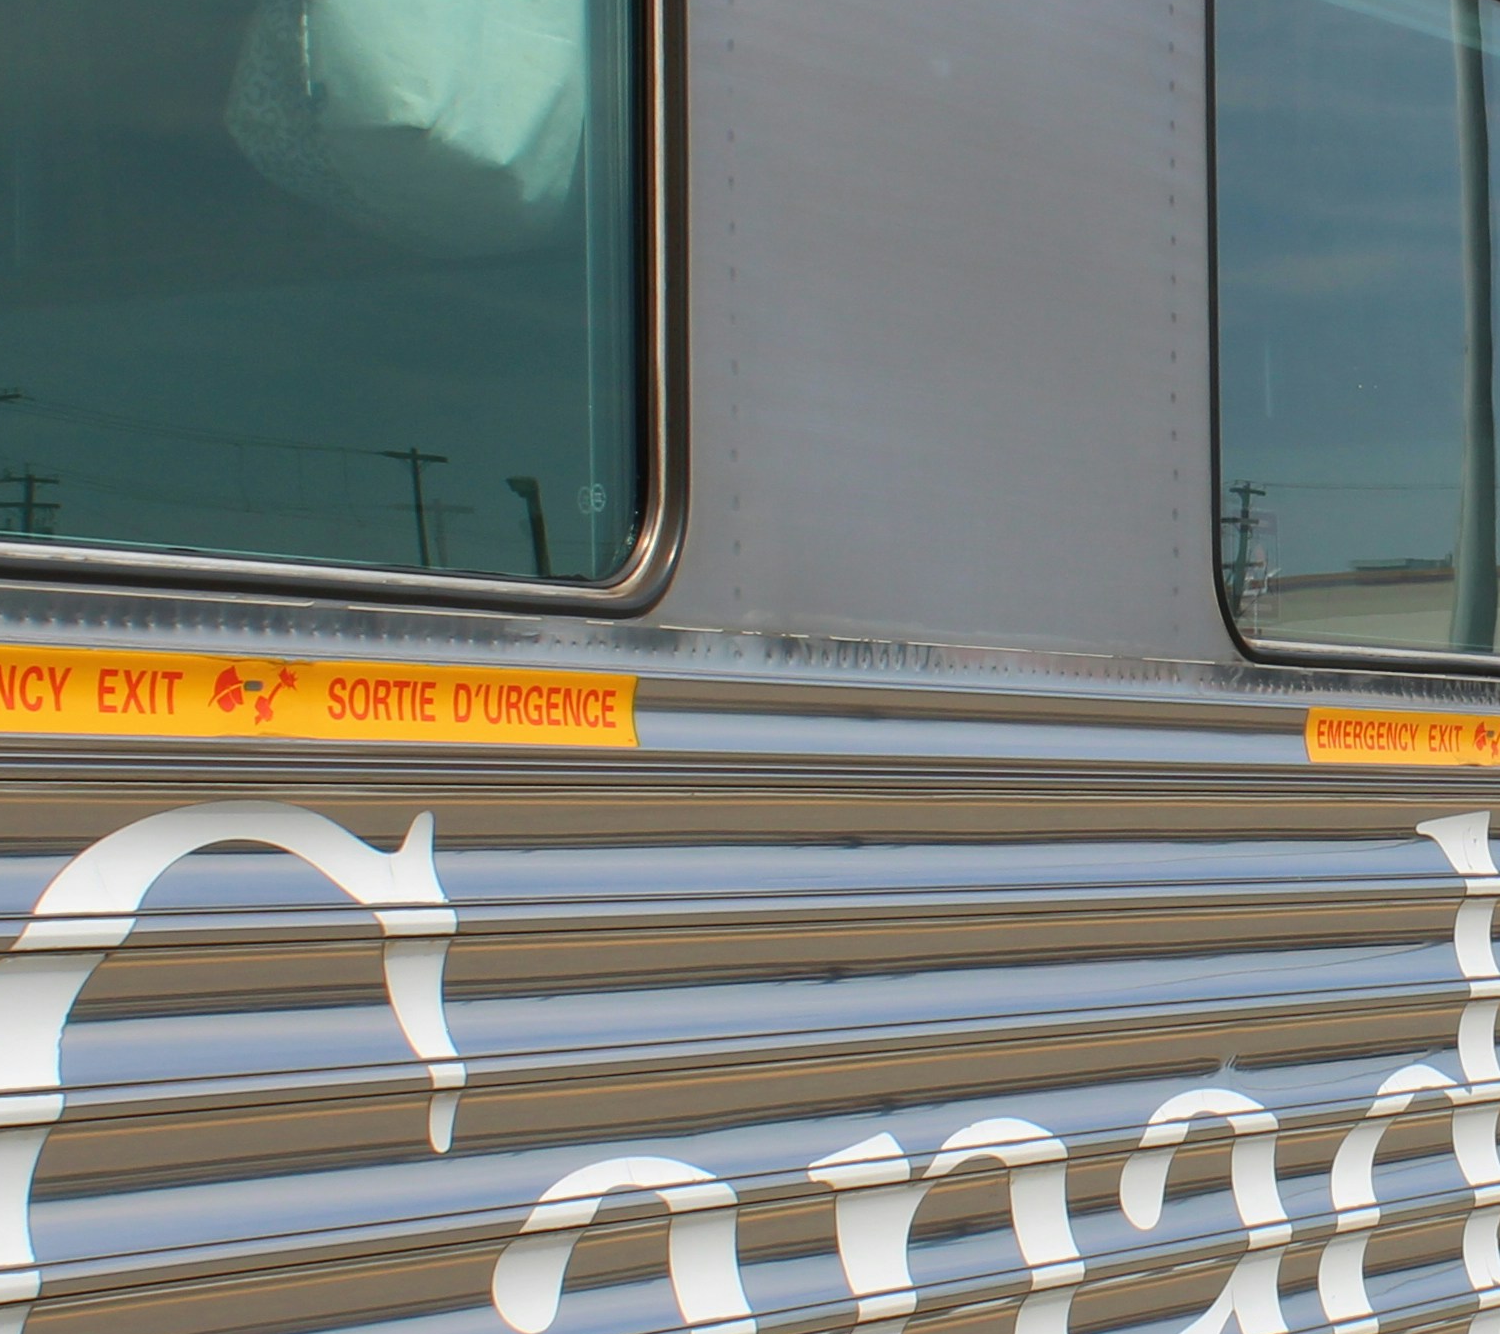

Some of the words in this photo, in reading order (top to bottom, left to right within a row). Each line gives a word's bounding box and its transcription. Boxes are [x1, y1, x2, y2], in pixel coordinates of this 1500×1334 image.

[97, 668, 184, 715] EXIT
[327, 677, 437, 723] SORTIE
[452, 682, 617, 729] D'URGENCE
[1316, 719, 1421, 753] EMERGENCY
[1428, 723, 1464, 754] EXIT
